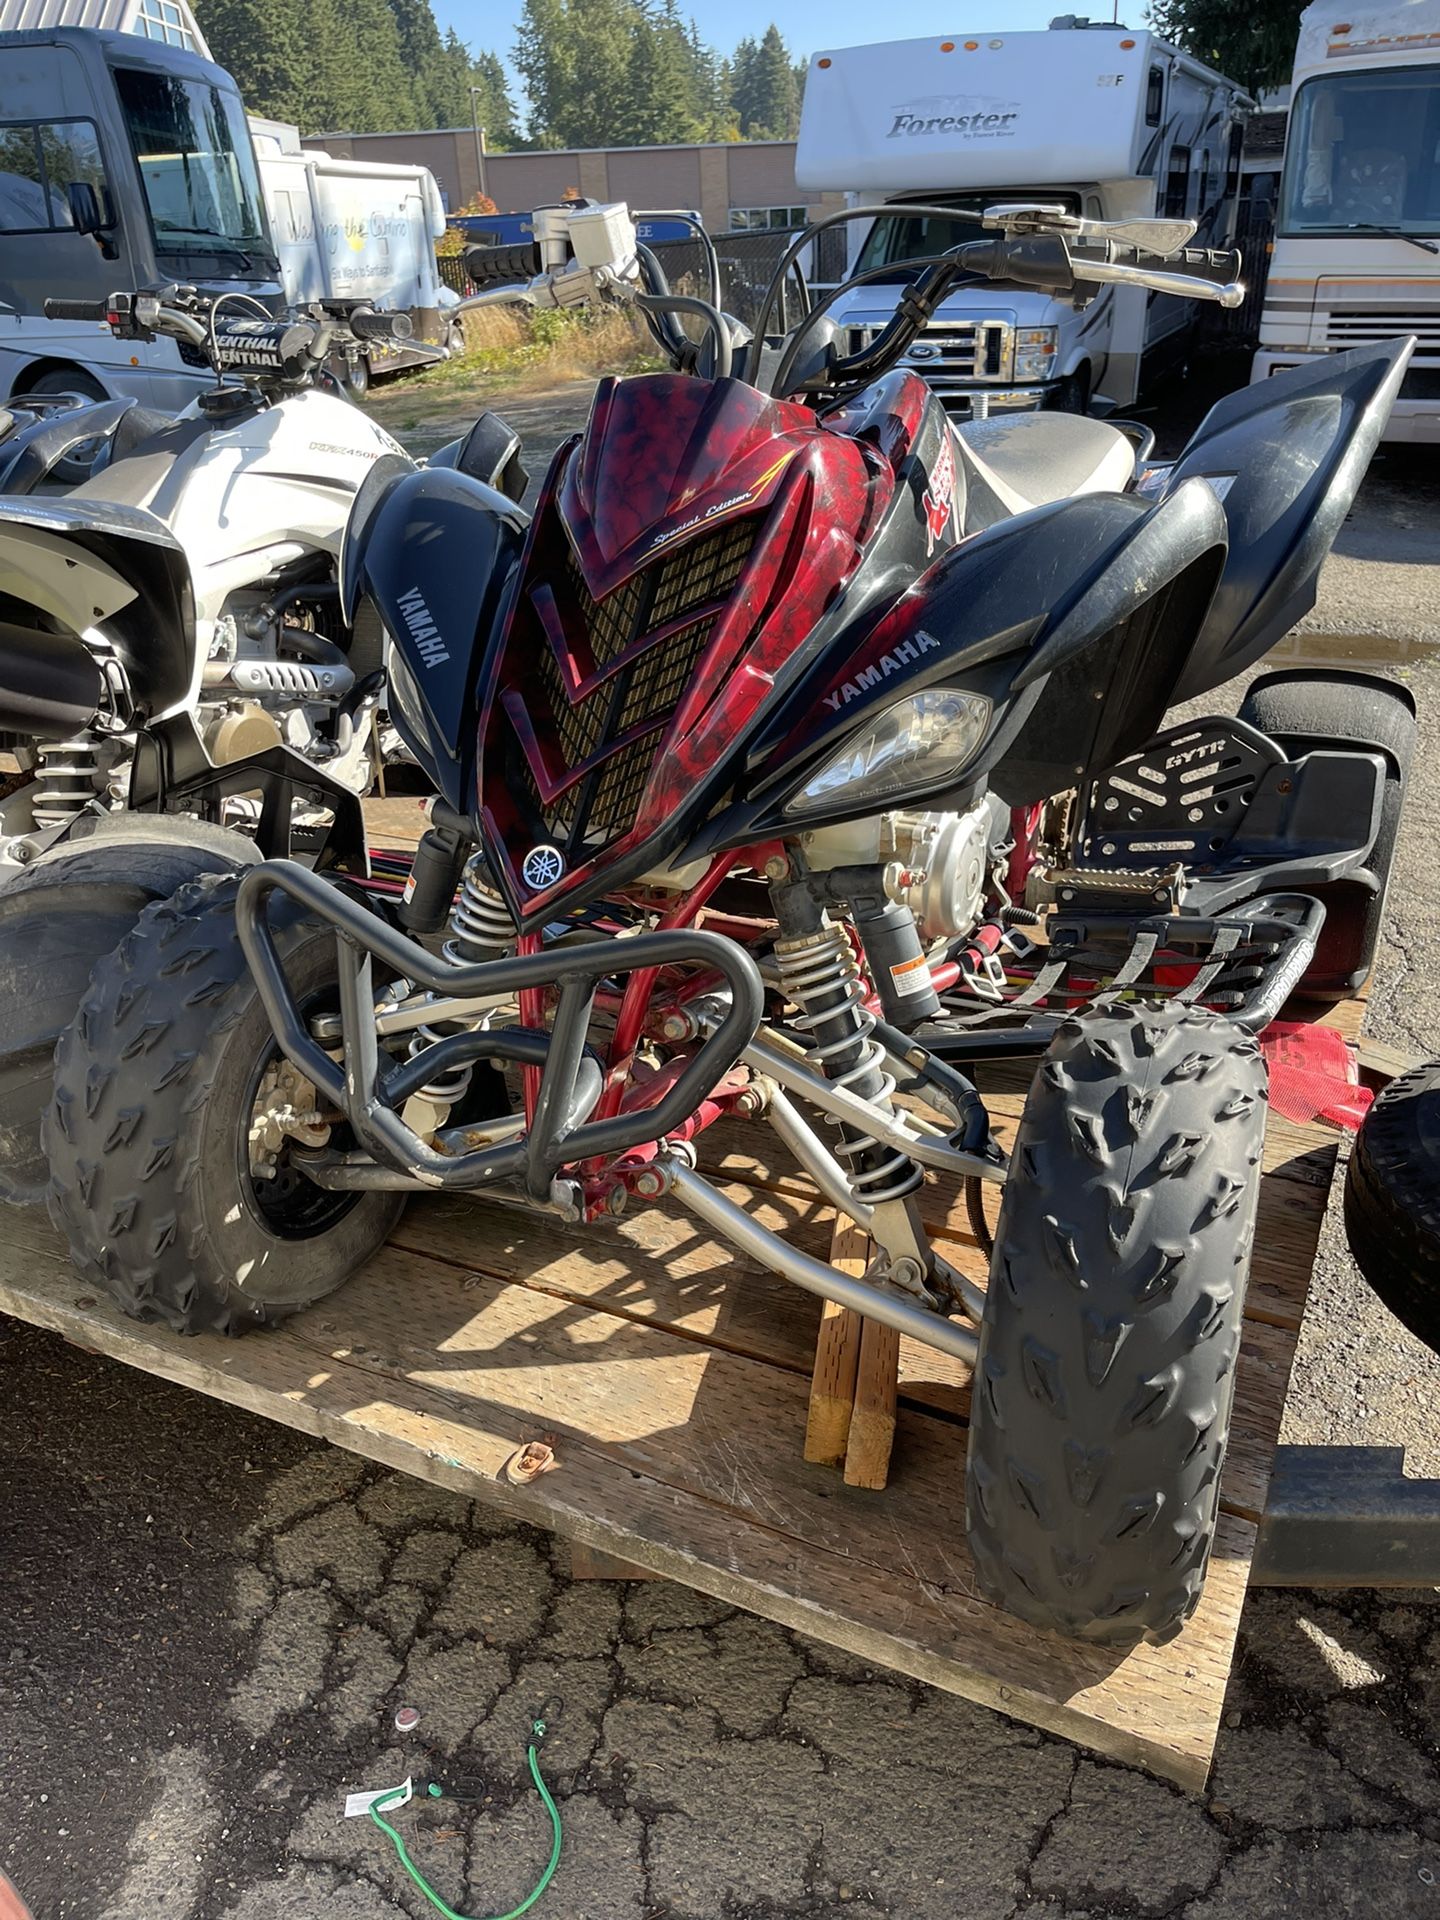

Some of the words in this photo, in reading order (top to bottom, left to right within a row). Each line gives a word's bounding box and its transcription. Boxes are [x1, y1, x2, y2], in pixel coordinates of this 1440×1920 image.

[886, 111, 1017, 139] Forester
[344, 215, 369, 239] the
[650, 515, 700, 548] Special
[705, 492, 752, 517] Edition
[396, 586, 450, 669] YAMAHA
[822, 630, 940, 711] YAMAHA
